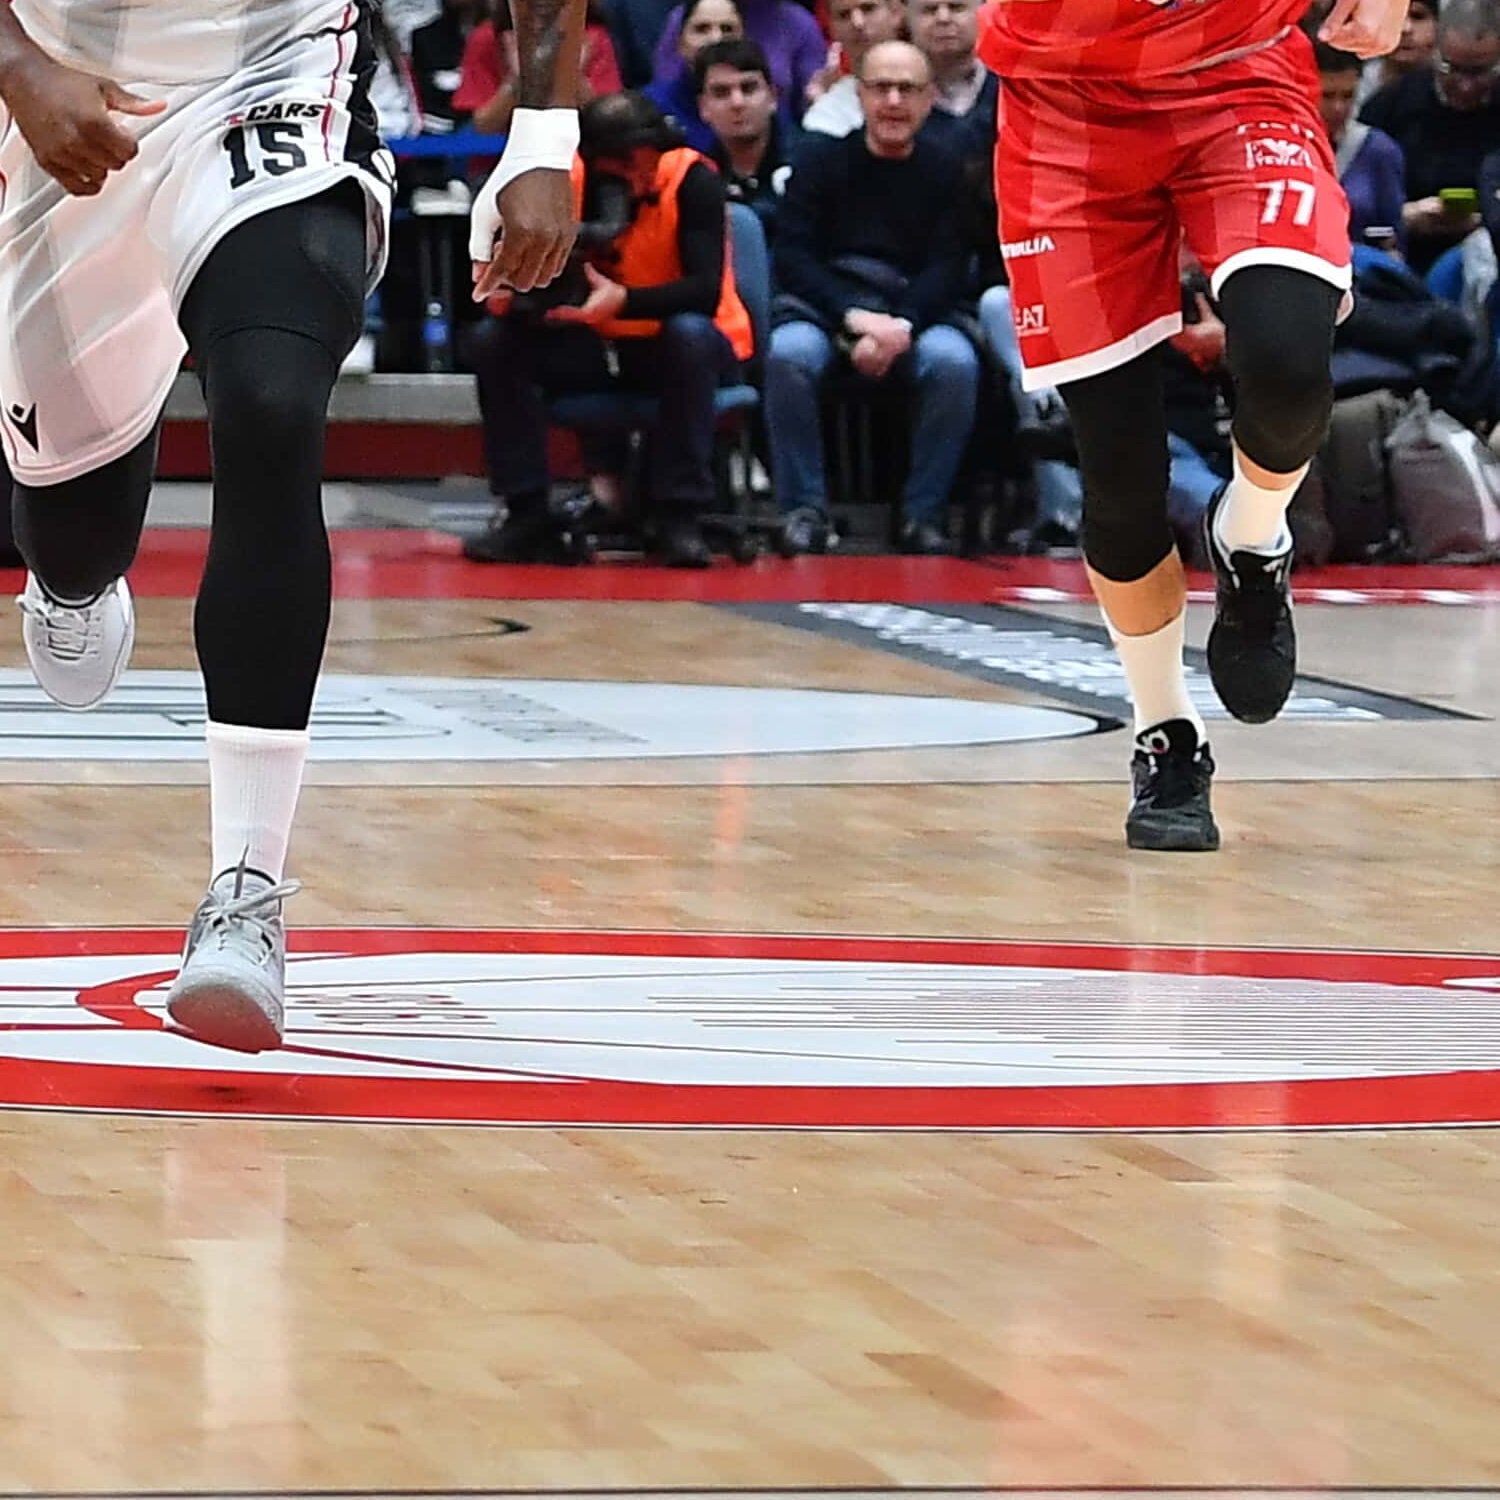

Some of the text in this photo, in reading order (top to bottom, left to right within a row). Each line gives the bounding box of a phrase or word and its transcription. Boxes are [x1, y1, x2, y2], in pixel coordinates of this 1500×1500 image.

[246, 102, 326, 122] CARS
[222, 121, 307, 190] 15
[1255, 178, 1316, 227] 77
